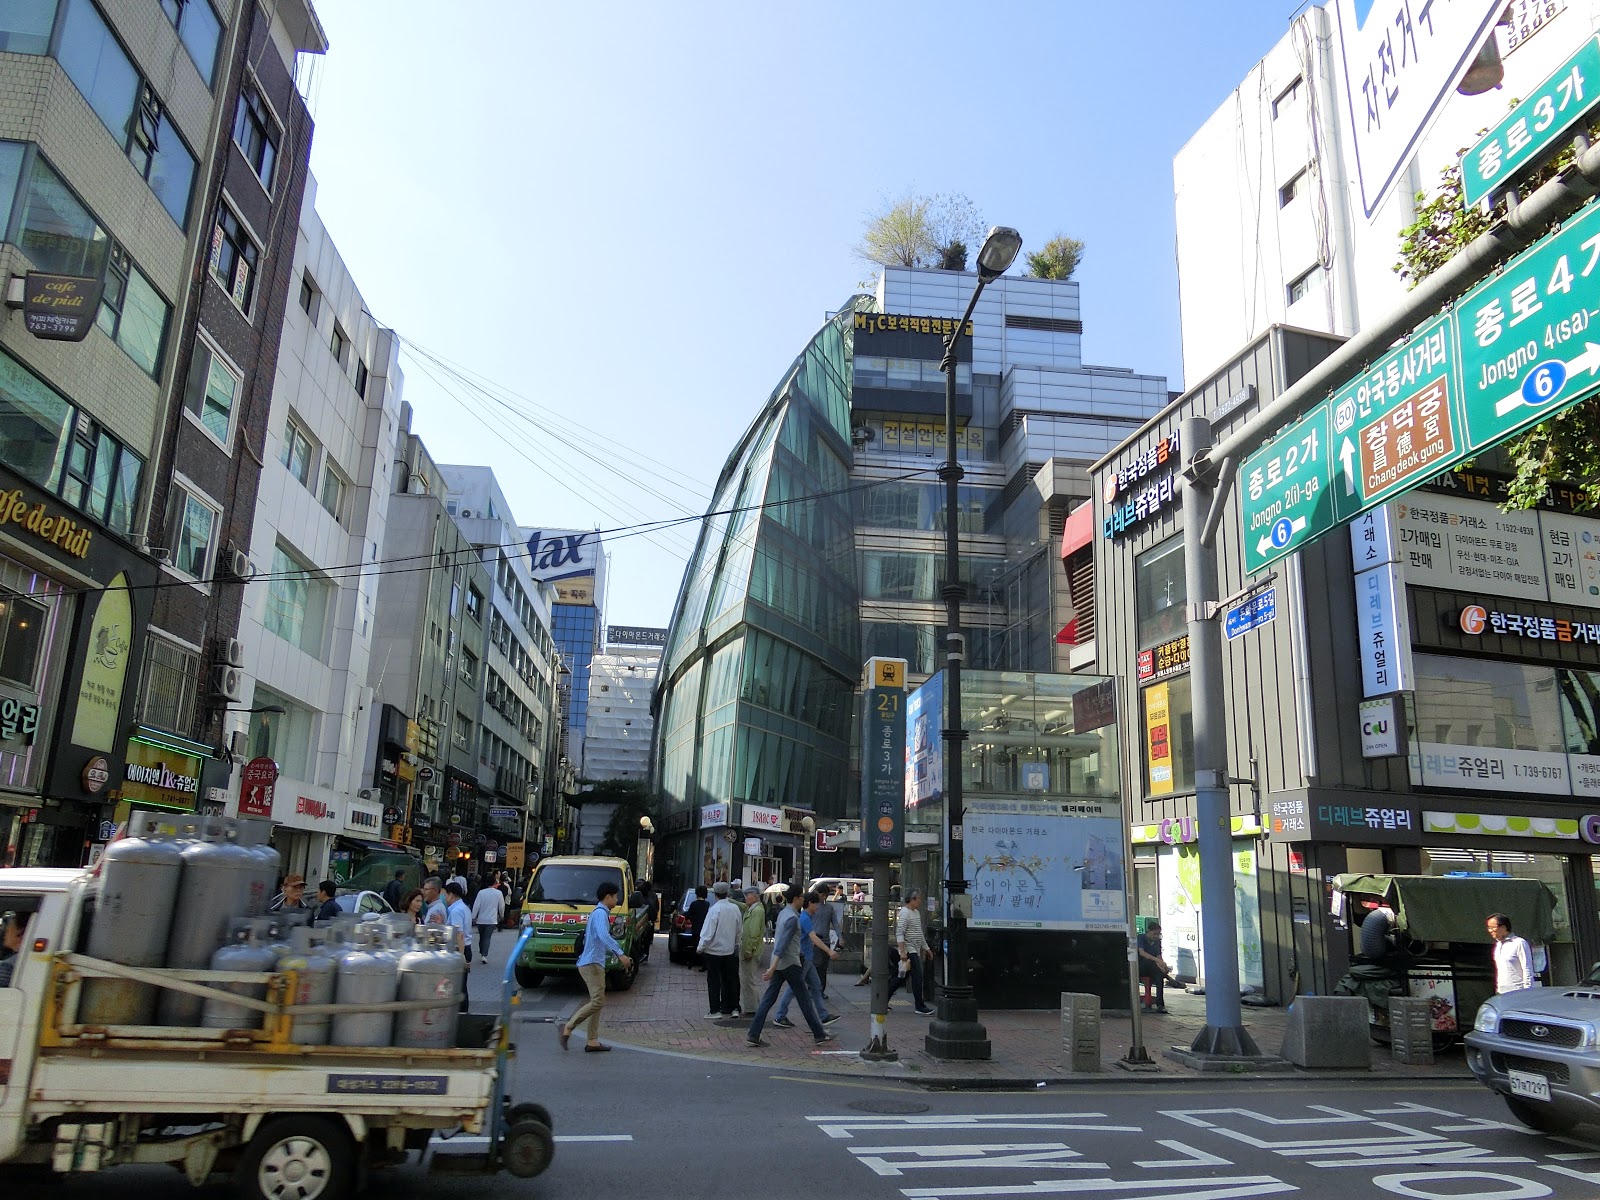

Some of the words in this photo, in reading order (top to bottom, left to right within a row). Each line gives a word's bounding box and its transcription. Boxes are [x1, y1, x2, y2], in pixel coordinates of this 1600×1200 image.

[1478, 65, 1584, 179] 종로3가
[45, 282, 76, 293] cafe
[32, 294, 51, 304] de
[50, 294, 84, 307] pidi
[29, 322, 76, 333] 763-3796
[1357, 326, 1447, 419] 안국동사거리
[1479, 340, 1538, 390] Jongno
[1535, 368, 1553, 397] 6
[1337, 406, 1352, 426] 50
[1366, 386, 1443, 450] 창덕궁
[1248, 427, 1319, 501] 종로2가
[1250, 500, 1281, 531] Jongno
[1409, 507, 1488, 530] 한국정품금거래소
[26, 504, 53, 538] de
[50, 516, 93, 559] Pidi
[1277, 522, 1287, 544] 6
[1455, 534, 1488, 548] 다이아몬드
[1549, 529, 1571, 547] 현금
[1409, 551, 1433, 569] 판매
[1552, 551, 1574, 569] 고가
[1554, 571, 1577, 590] 매입
[1367, 574, 1389, 687] 디레브쥬얼리
[877, 693, 899, 712] 2-1
[880, 725, 894, 776] 종로3가
[247, 770, 274, 781] 중국요리
[1409, 753, 1505, 780] 디레브쥬얼리
[1523, 765, 1562, 780] 739-6767
[175, 775, 196, 793] 쥬얼리
[1061, 804, 1102, 814] 엘리베이터
[1273, 800, 1304, 816] 한국정품
[1318, 806, 1411, 831] 디레브쥬얼리
[988, 826, 1024, 836] 다이아몬드
